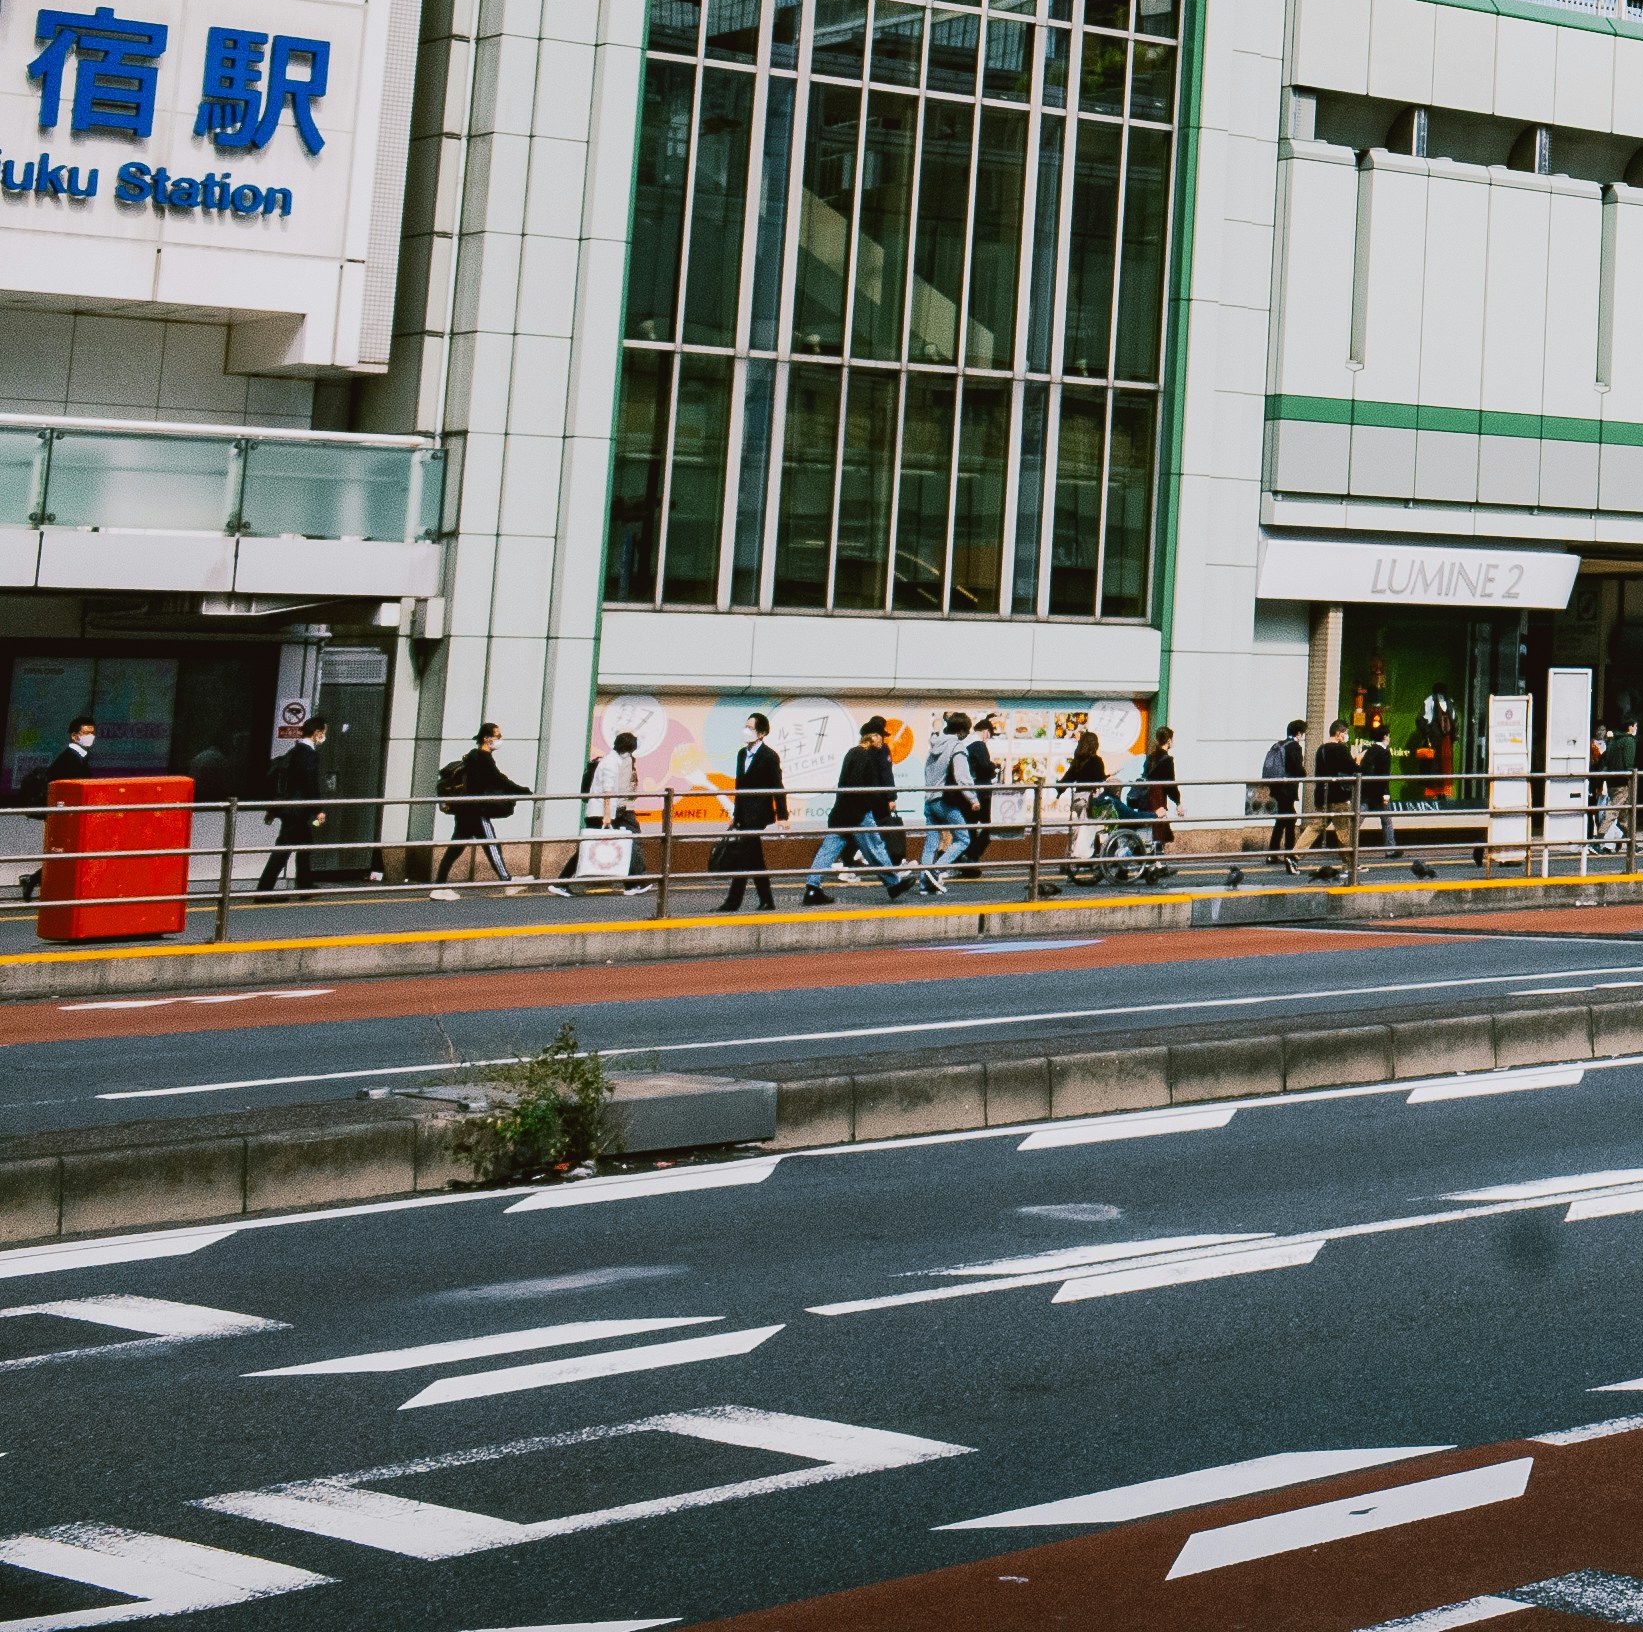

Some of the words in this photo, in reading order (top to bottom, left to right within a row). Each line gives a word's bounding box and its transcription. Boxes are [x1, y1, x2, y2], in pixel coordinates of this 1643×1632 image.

[27, 6, 331, 155] 宿駅
[0, 151, 99, 197] uku
[115, 161, 293, 217] Station
[1371, 557, 1500, 599] LUMINE
[1501, 564, 1525, 599] 2
